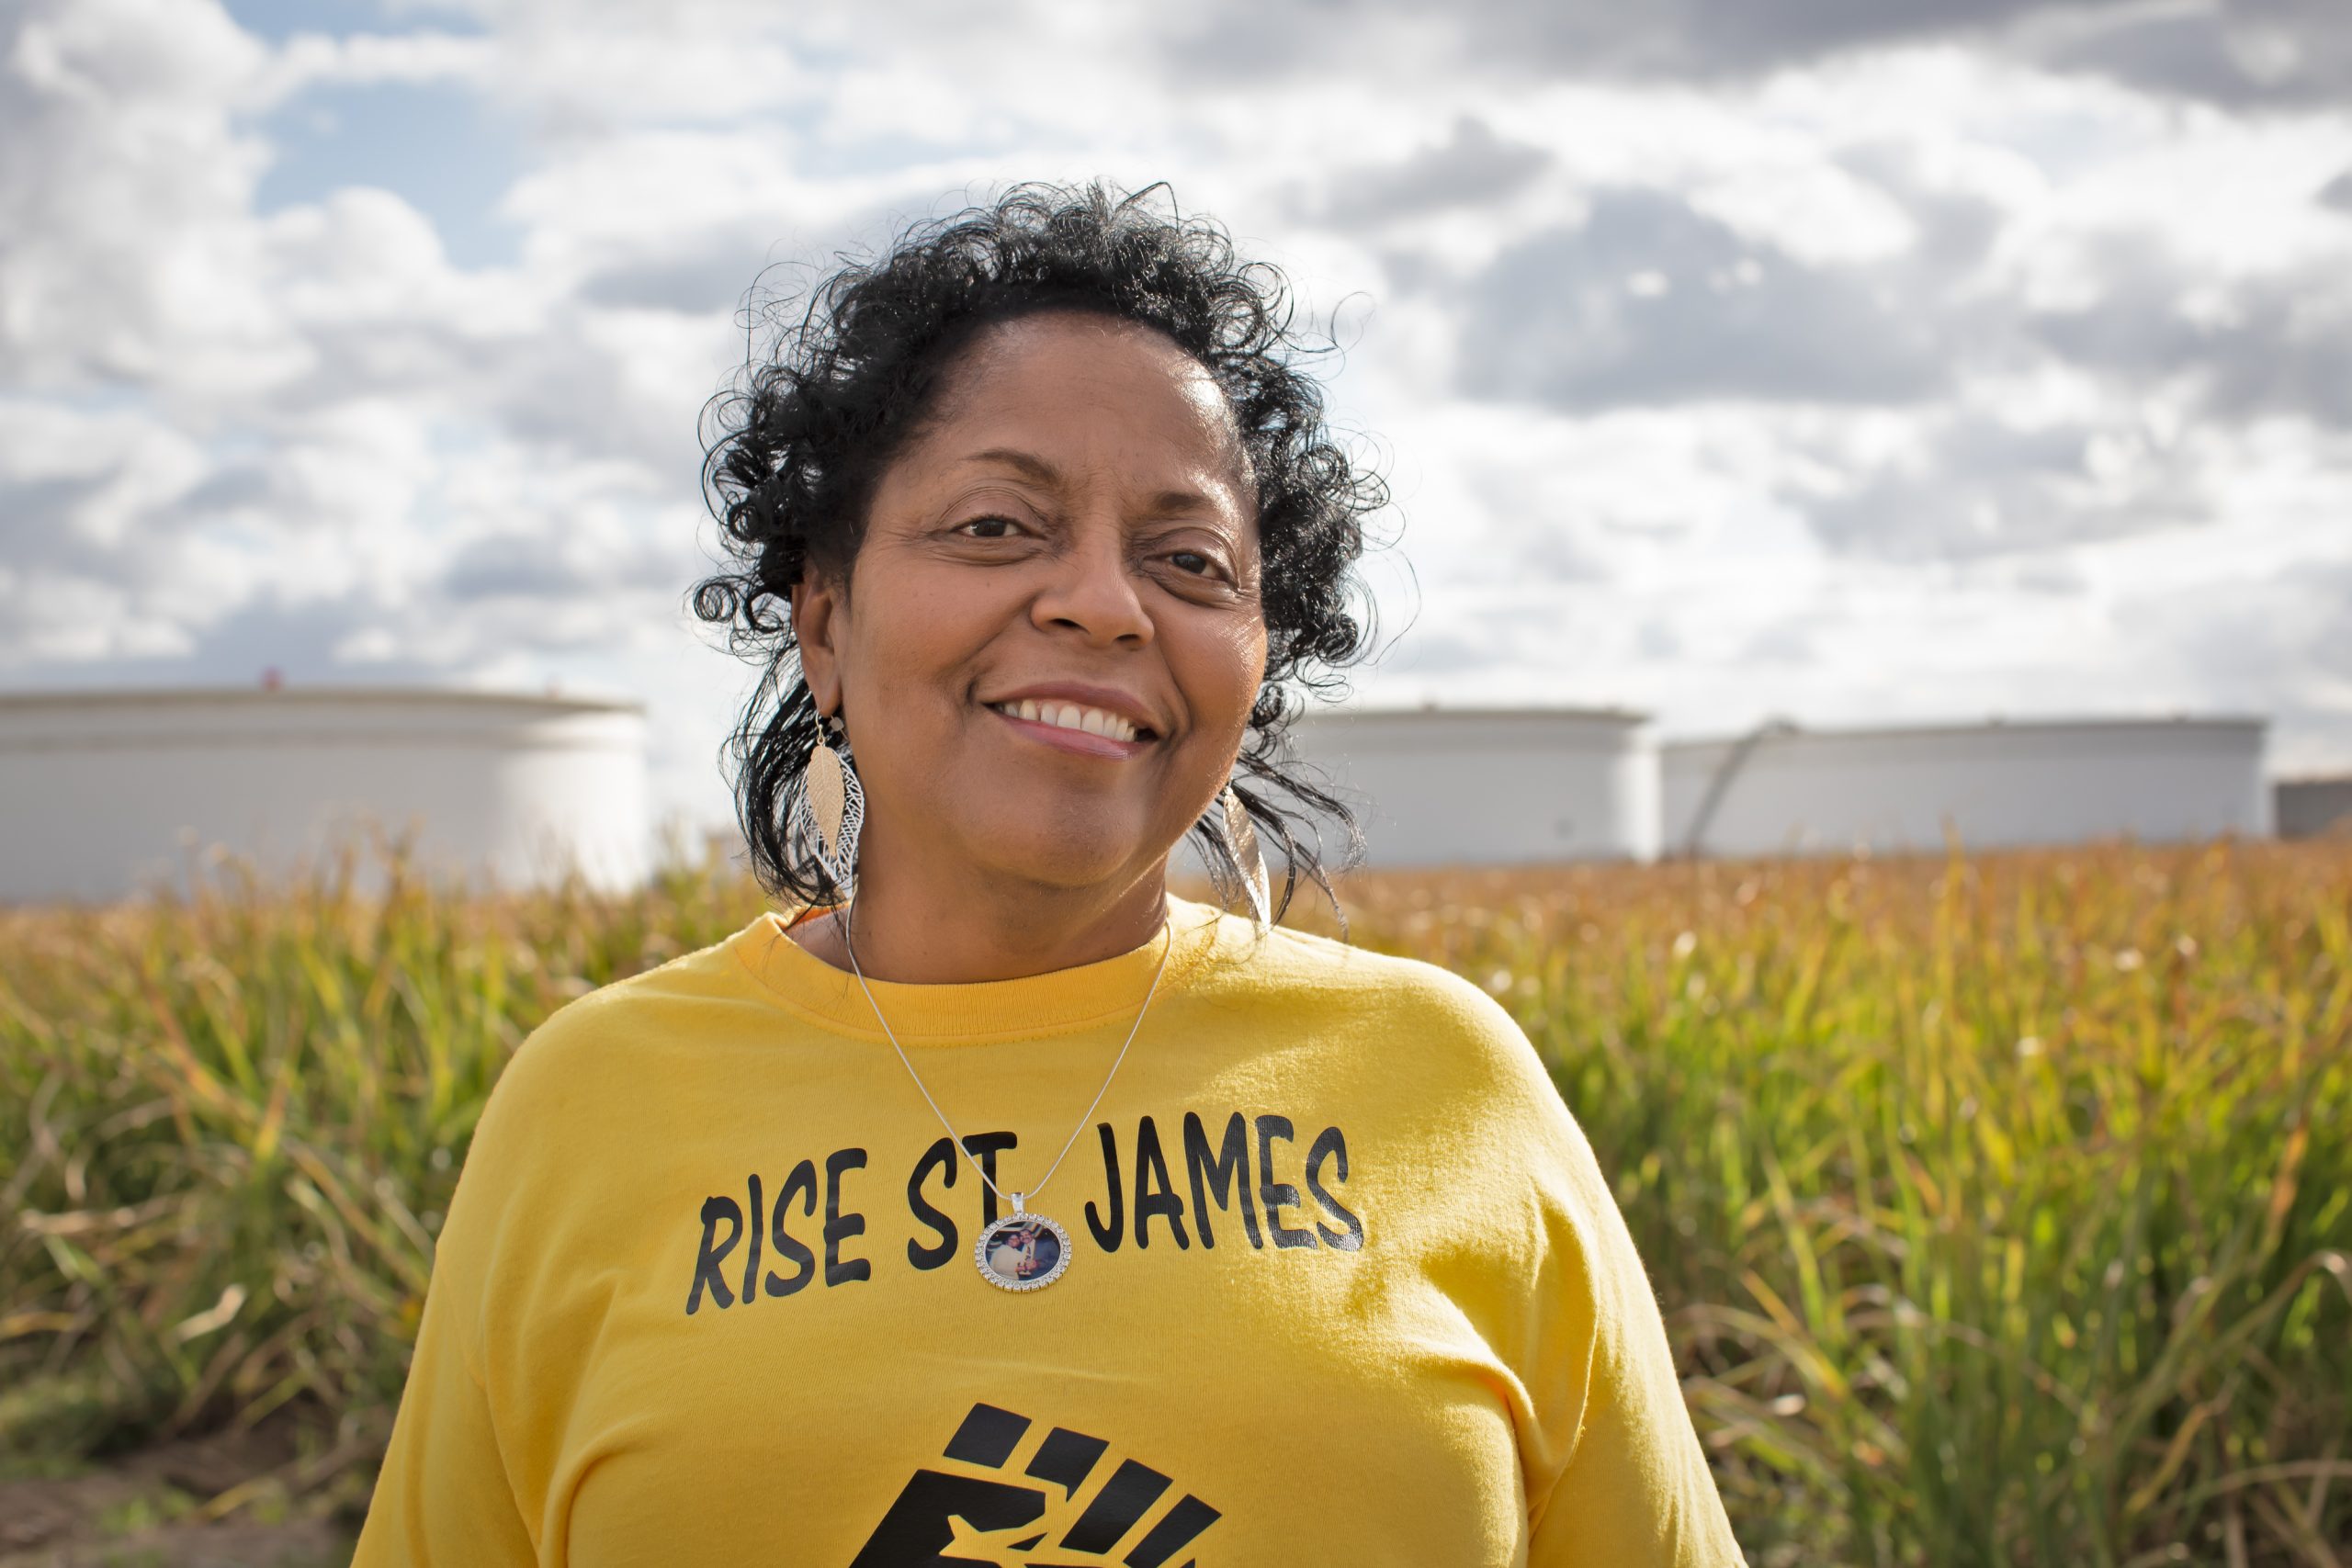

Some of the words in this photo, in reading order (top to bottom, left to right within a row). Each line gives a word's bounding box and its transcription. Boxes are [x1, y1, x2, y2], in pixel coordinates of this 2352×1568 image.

[685, 1147, 872, 1316] RISE
[906, 1131, 1018, 1271] ST
[1084, 1111, 1364, 1254] JAMES
